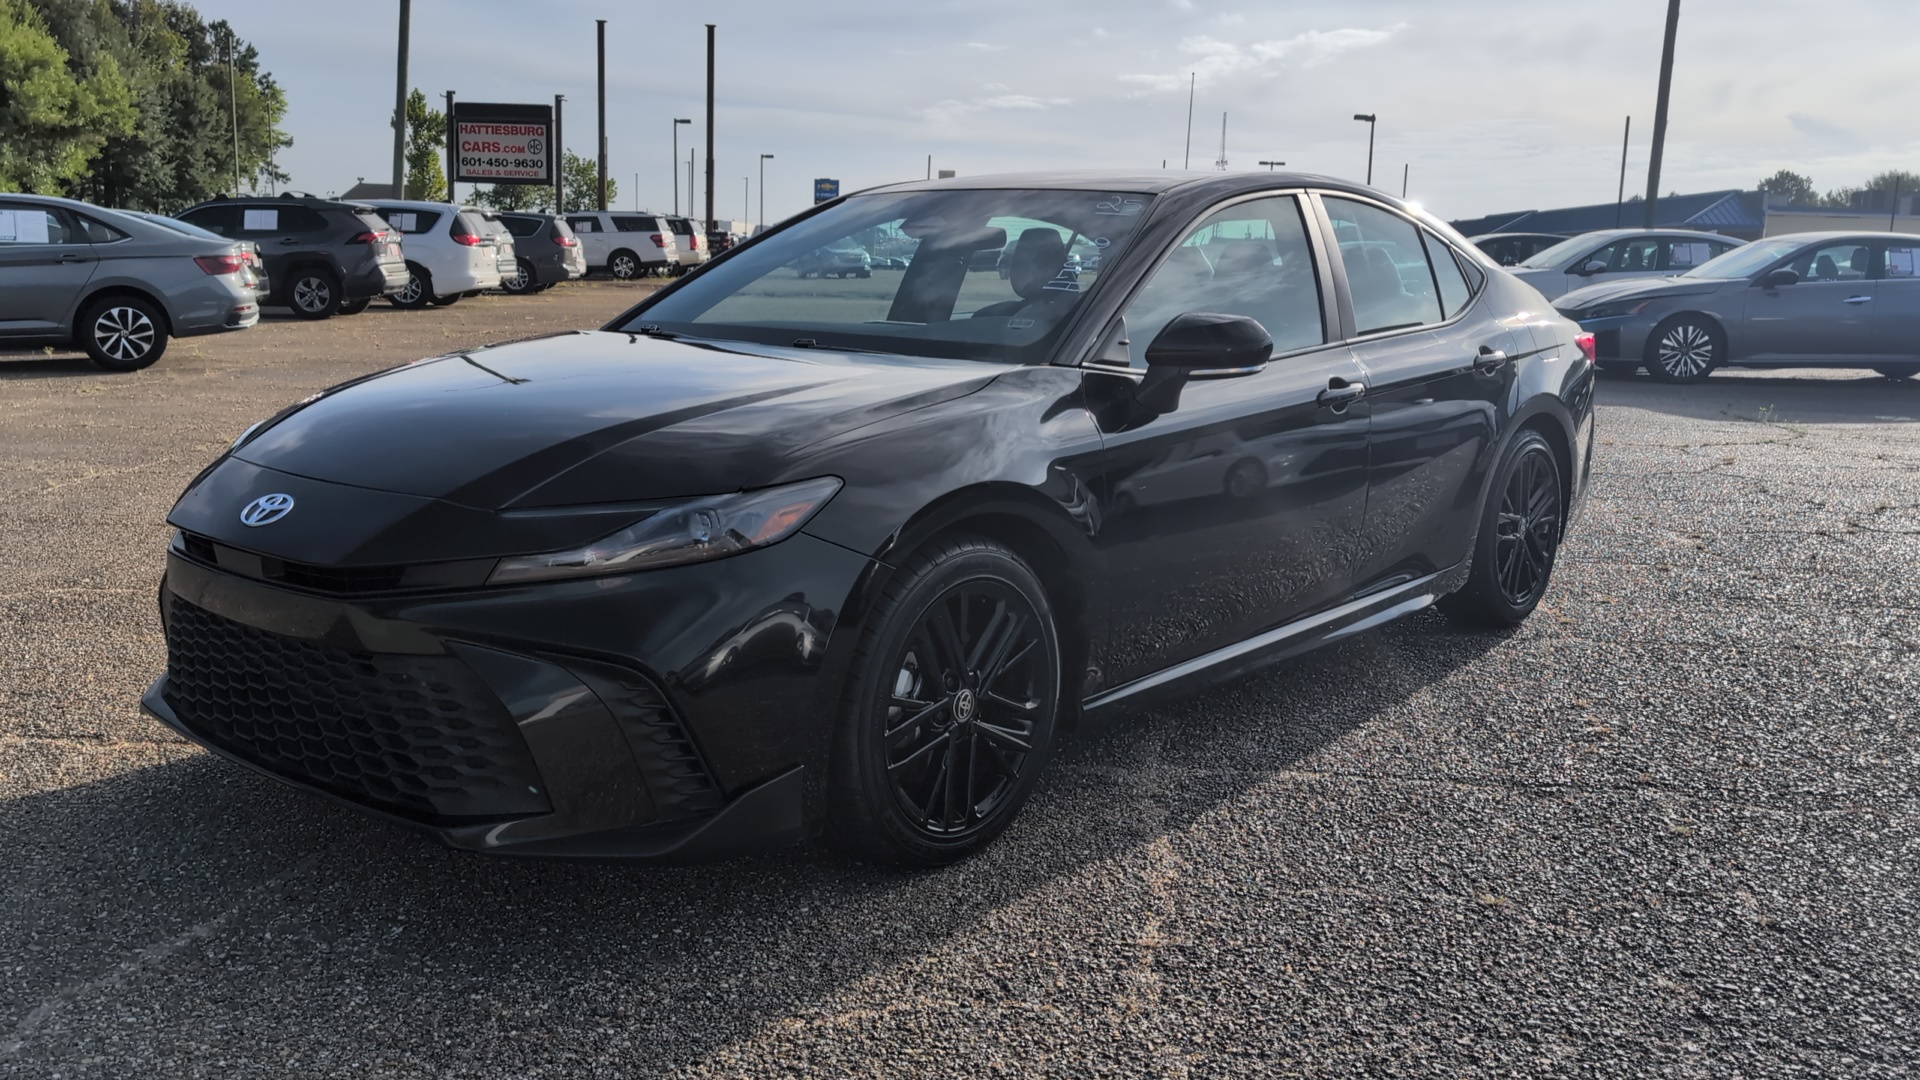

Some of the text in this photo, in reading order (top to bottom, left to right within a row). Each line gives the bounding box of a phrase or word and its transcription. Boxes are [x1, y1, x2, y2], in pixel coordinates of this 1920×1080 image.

[460, 124, 544, 136] HATTIESBURG
[466, 168, 493, 176] SALES
[504, 169, 539, 177] SERVICE
[1096, 195, 1142, 211] 25
